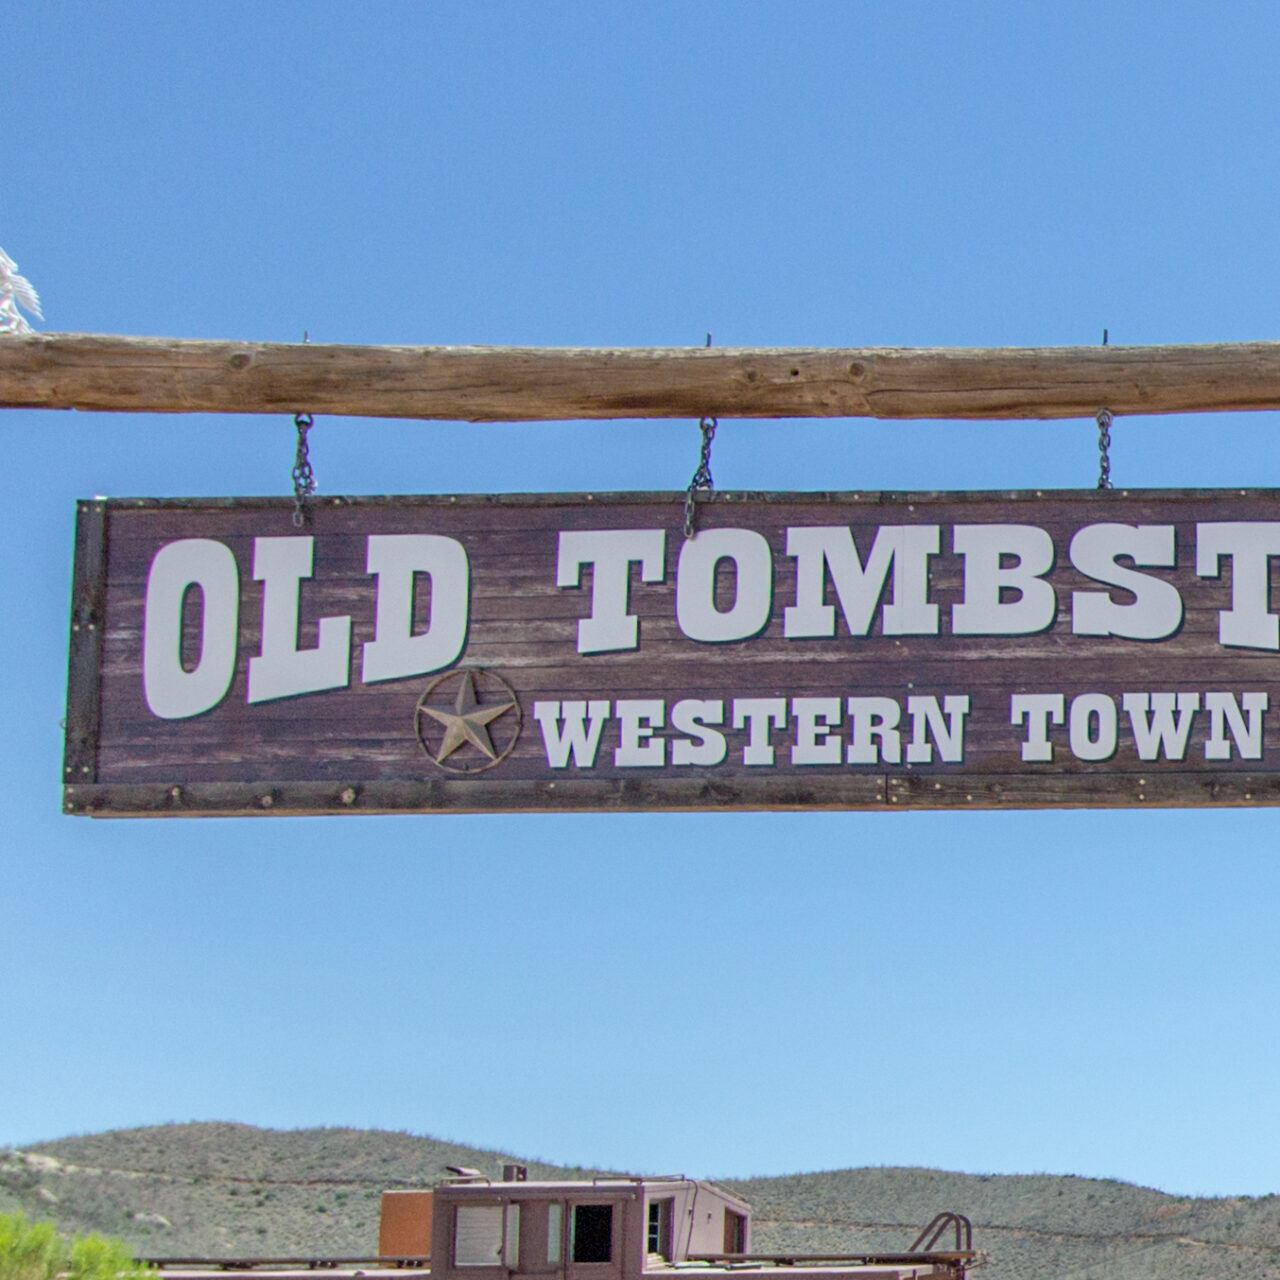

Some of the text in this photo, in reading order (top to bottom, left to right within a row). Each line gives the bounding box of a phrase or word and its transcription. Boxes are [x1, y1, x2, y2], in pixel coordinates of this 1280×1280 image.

[143, 535, 471, 719] OLD
[534, 691, 1268, 768] WESTERN TOWN
